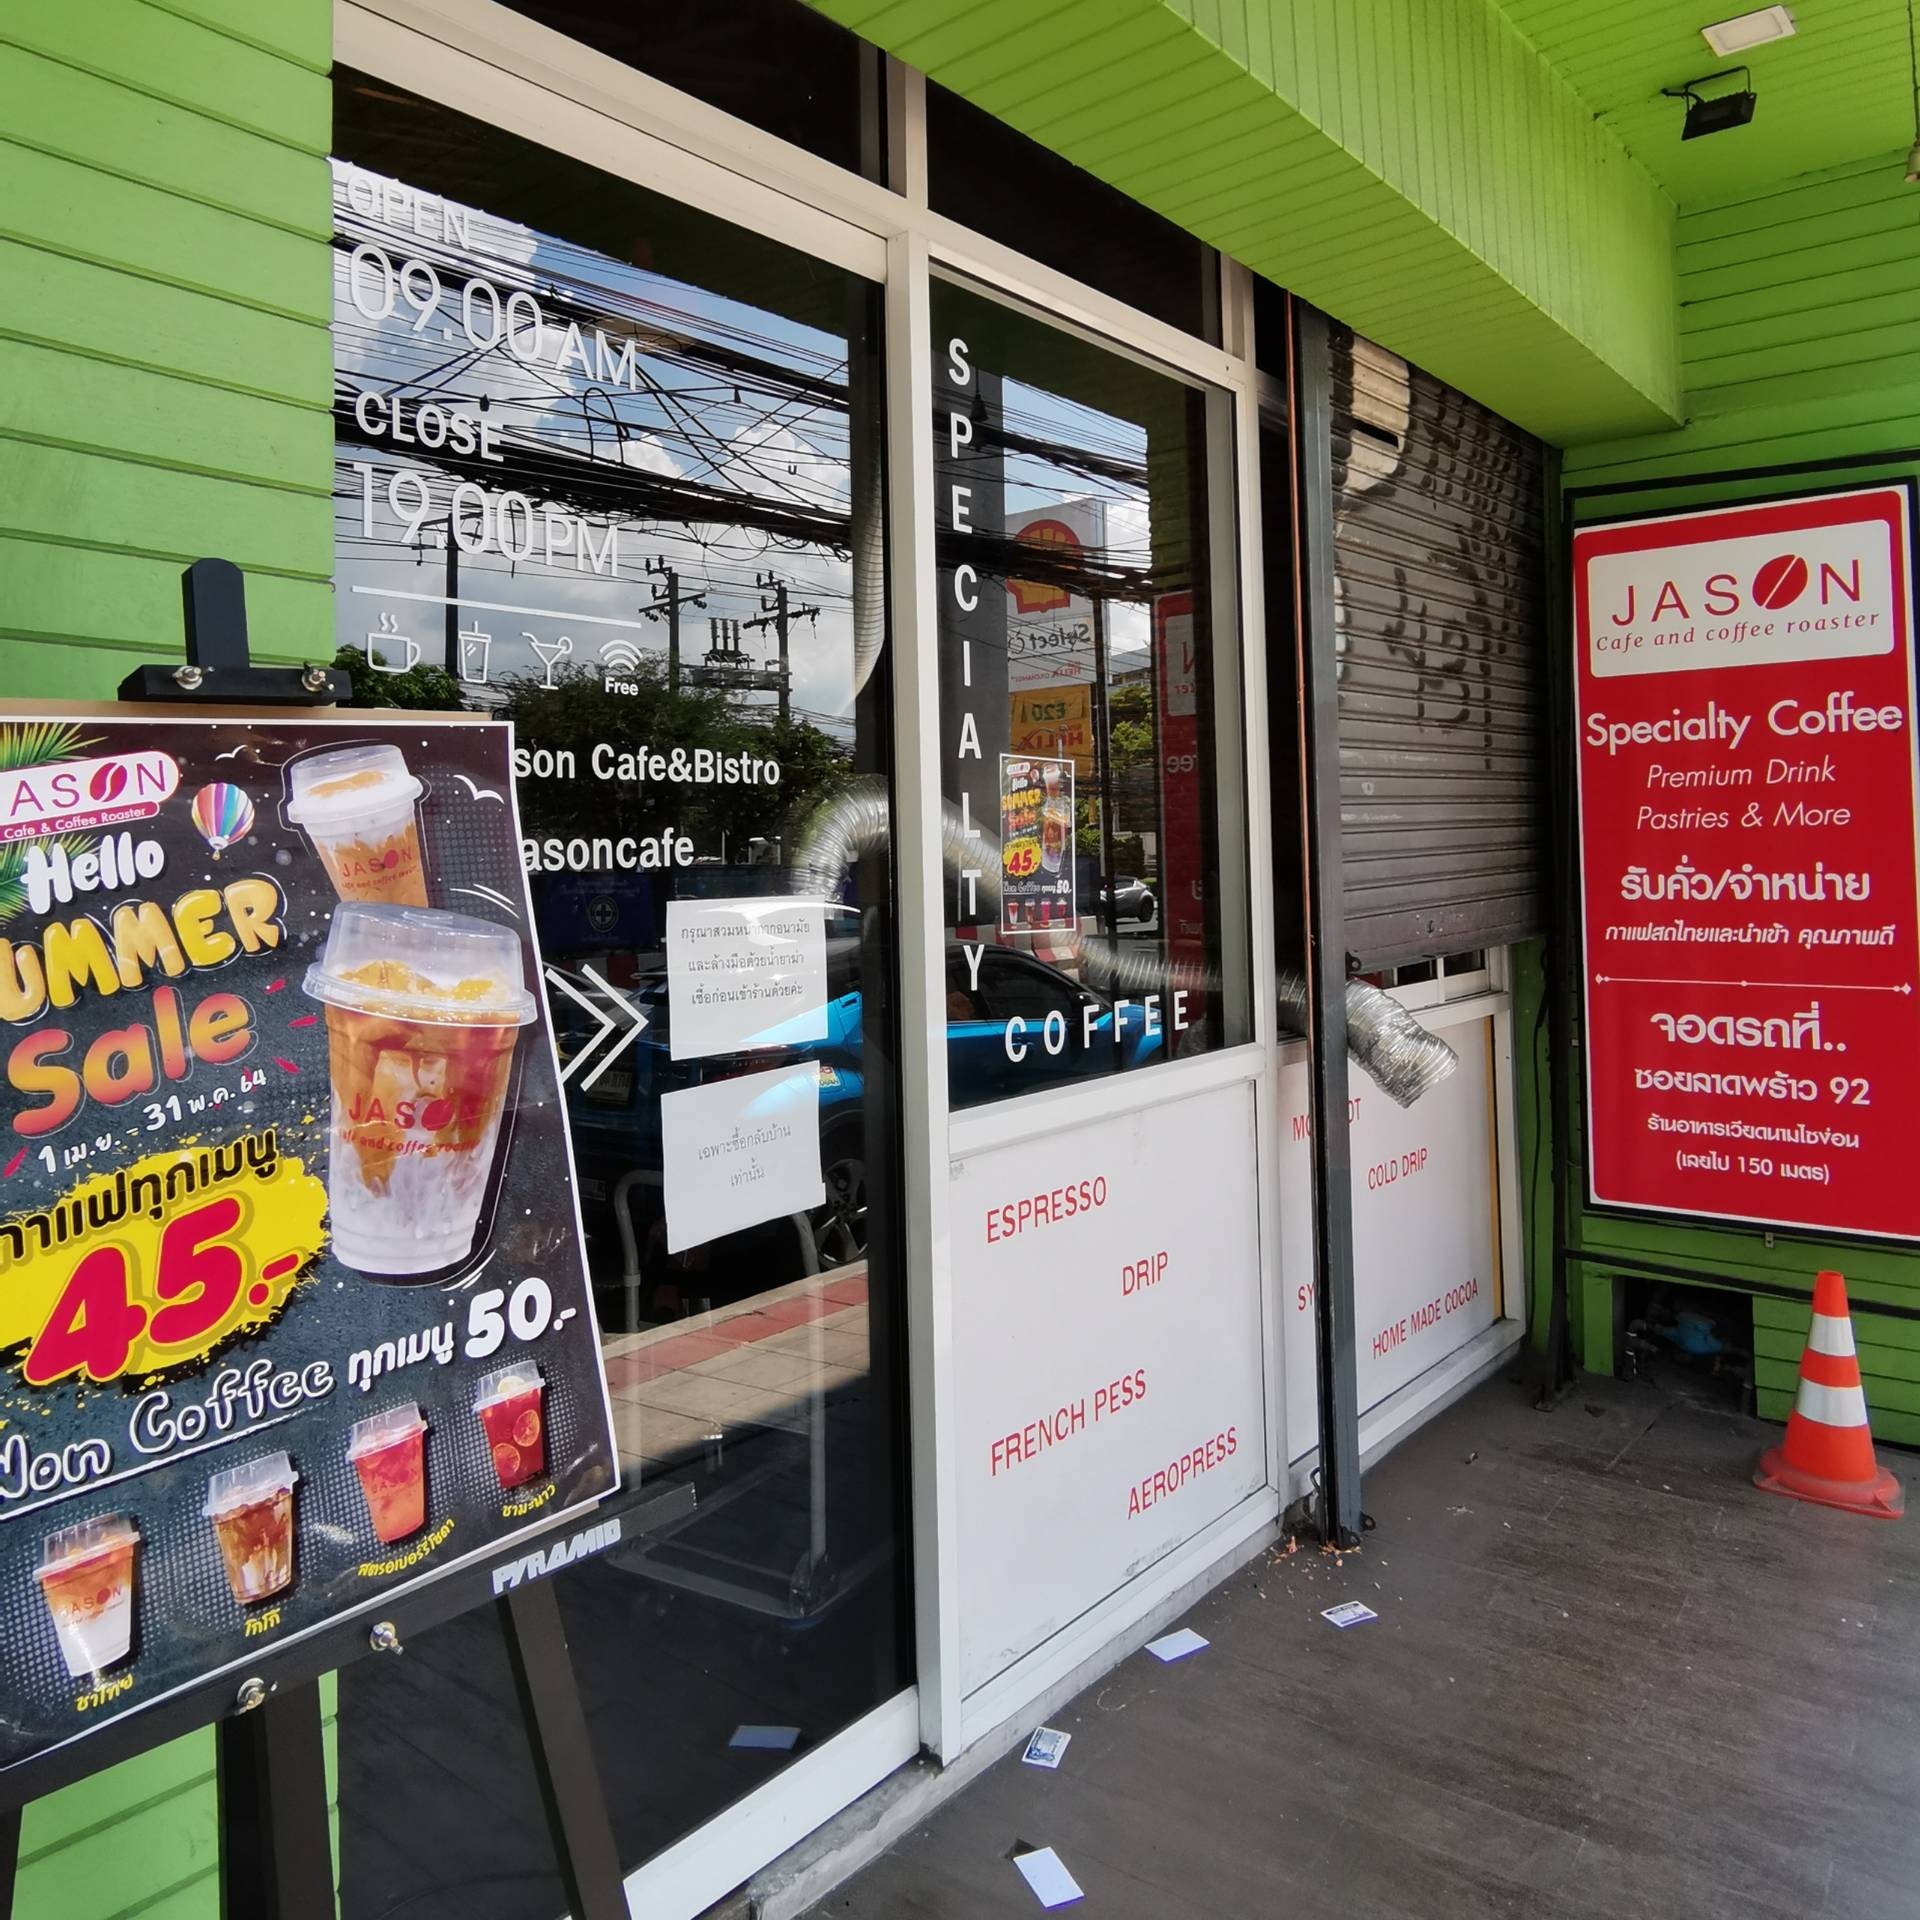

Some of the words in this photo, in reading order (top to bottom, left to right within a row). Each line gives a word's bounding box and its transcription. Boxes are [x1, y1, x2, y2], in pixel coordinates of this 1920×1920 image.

[347, 176, 471, 250] OPEN
[355, 391, 504, 462] CLOSE
[1611, 553, 1861, 627] JASON
[1596, 631, 1644, 655] Cafe
[1653, 626, 1695, 646] and
[1705, 621, 1776, 645] coffee
[1786, 612, 1880, 635] roaster
[604, 676, 639, 696] Free
[1586, 701, 1751, 756] Specialty
[1767, 690, 1903, 736] Coffee
[9, 759, 166, 817] ASON
[512, 747, 576, 779] son
[591, 743, 781, 786] Cafe&Bistro
[1646, 764, 1752, 789] Premium
[1765, 754, 1837, 784] Drink
[4, 826, 36, 840] Cafe
[40, 823, 51, 834] &
[55, 816, 97, 831] Coffee
[101, 806, 146, 824] Roaster
[1636, 805, 1729, 831] Pastries
[1740, 802, 1763, 828] &
[1772, 801, 1851, 827] More
[20, 831, 165, 915] Hello
[521, 827, 695, 873] asoncafe
[1620, 854, 1871, 901] รับคั่ว/จำหน่าย
[0, 878, 281, 1023] UMMER
[1797, 923, 1897, 951] คุณภาพดี
[1004, 990, 1189, 1063] COFFEE
[7, 985, 252, 1137] Sale
[1634, 1069, 1818, 1102] ซอยลาดพร้าว
[1829, 1077, 1871, 1106] 92
[38, 1145, 57, 1174] 1
[143, 1095, 183, 1132] 31
[1367, 1159, 1398, 1191] COLD
[1402, 1147, 1429, 1178] DRIP
[1675, 1150, 1730, 1171] (เลยไป
[1737, 1156, 1773, 1176] 150
[1780, 1163, 1831, 1186] เมตร)
[986, 1175, 1107, 1244] ESPRESSO
[1122, 1251, 1168, 1296] DRIP
[1372, 1319, 1407, 1360] HOME
[1411, 1298, 1442, 1336] MADE
[1445, 1277, 1480, 1315] COCOA
[348, 1321, 456, 1392] ทุกเมนู
[129, 1358, 335, 1453] Coffee
[991, 1397, 1085, 1477] FRENCH
[1094, 1368, 1147, 1422] PESS
[502, 1483, 557, 1518] ชามะนาว
[1127, 1426, 1238, 1521] AEROPRESS
[490, 1518, 622, 1595] PYRAMID
[75, 1673, 134, 1712] ชาไทย
